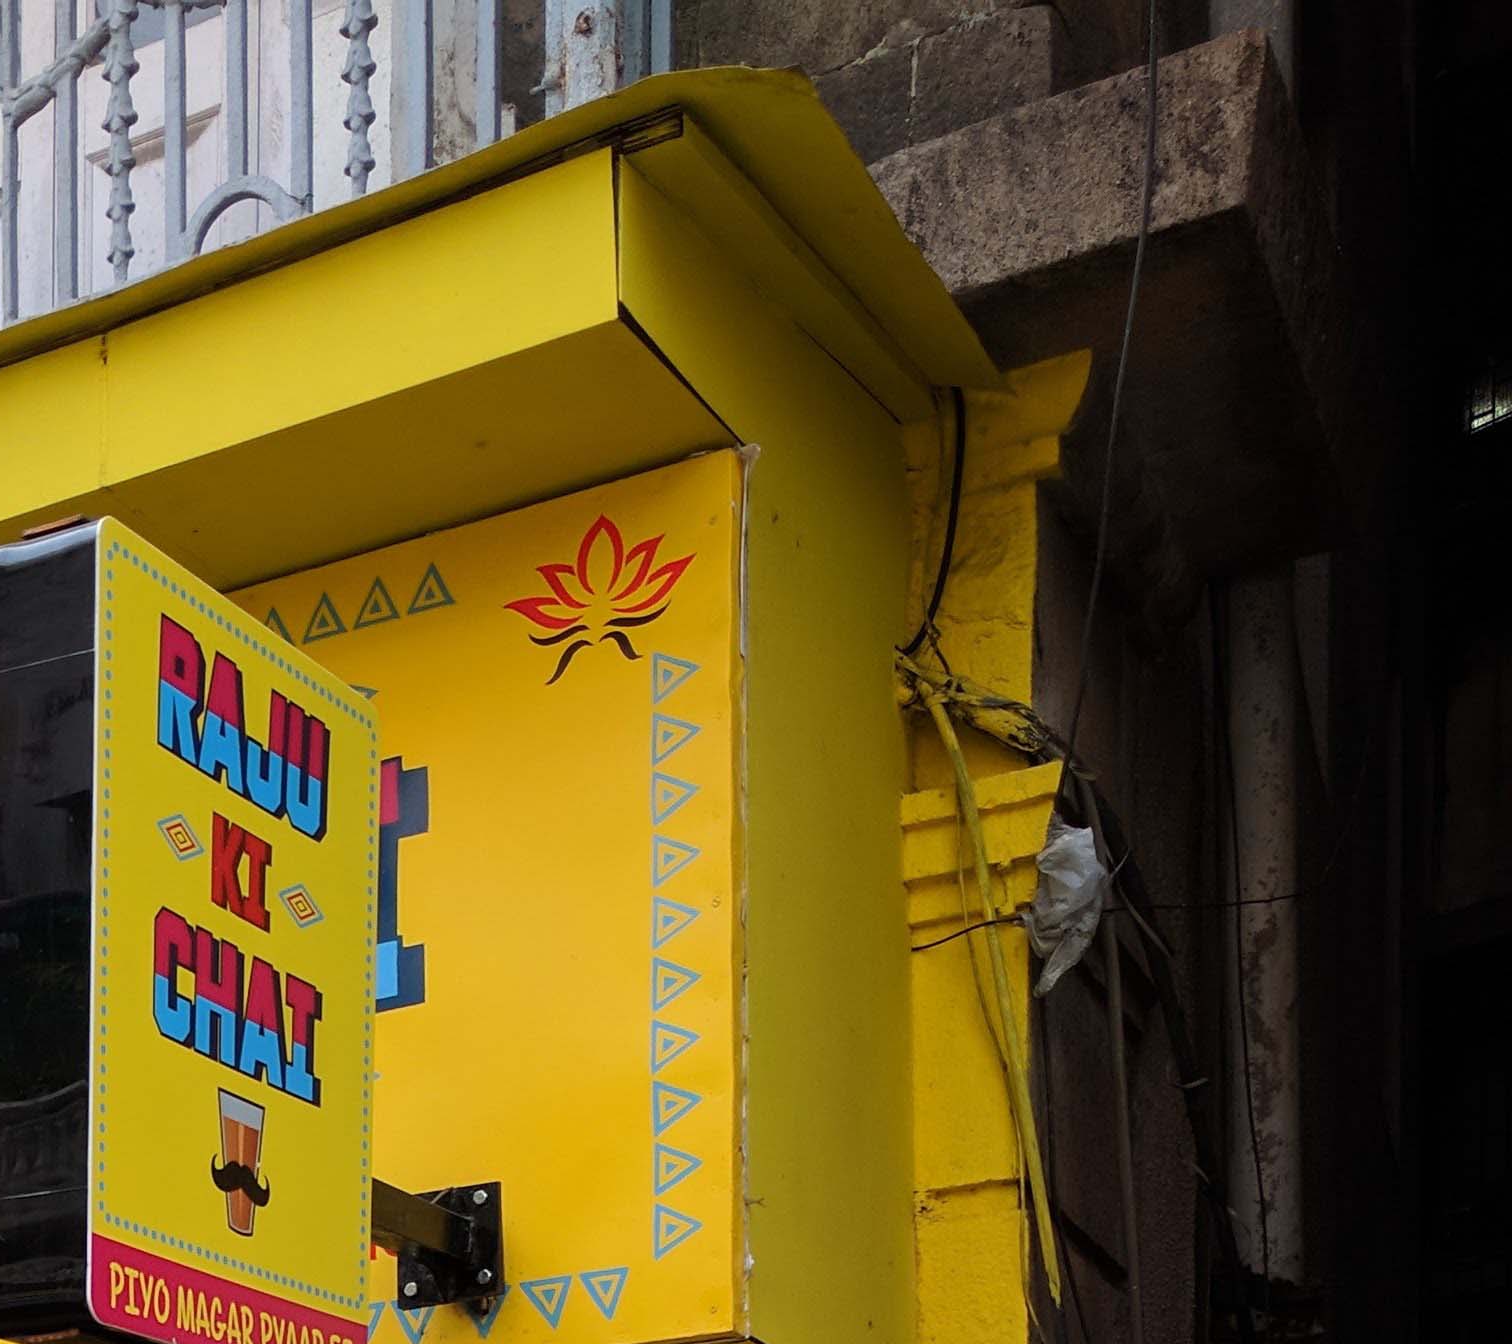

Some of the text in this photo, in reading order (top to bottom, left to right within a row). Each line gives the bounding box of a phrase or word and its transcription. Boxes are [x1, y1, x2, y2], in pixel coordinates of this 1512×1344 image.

[156, 612, 330, 844] RAJU
[210, 812, 273, 933] KI
[152, 905, 323, 1107] CHAI
[109, 1262, 171, 1327] PIYO
